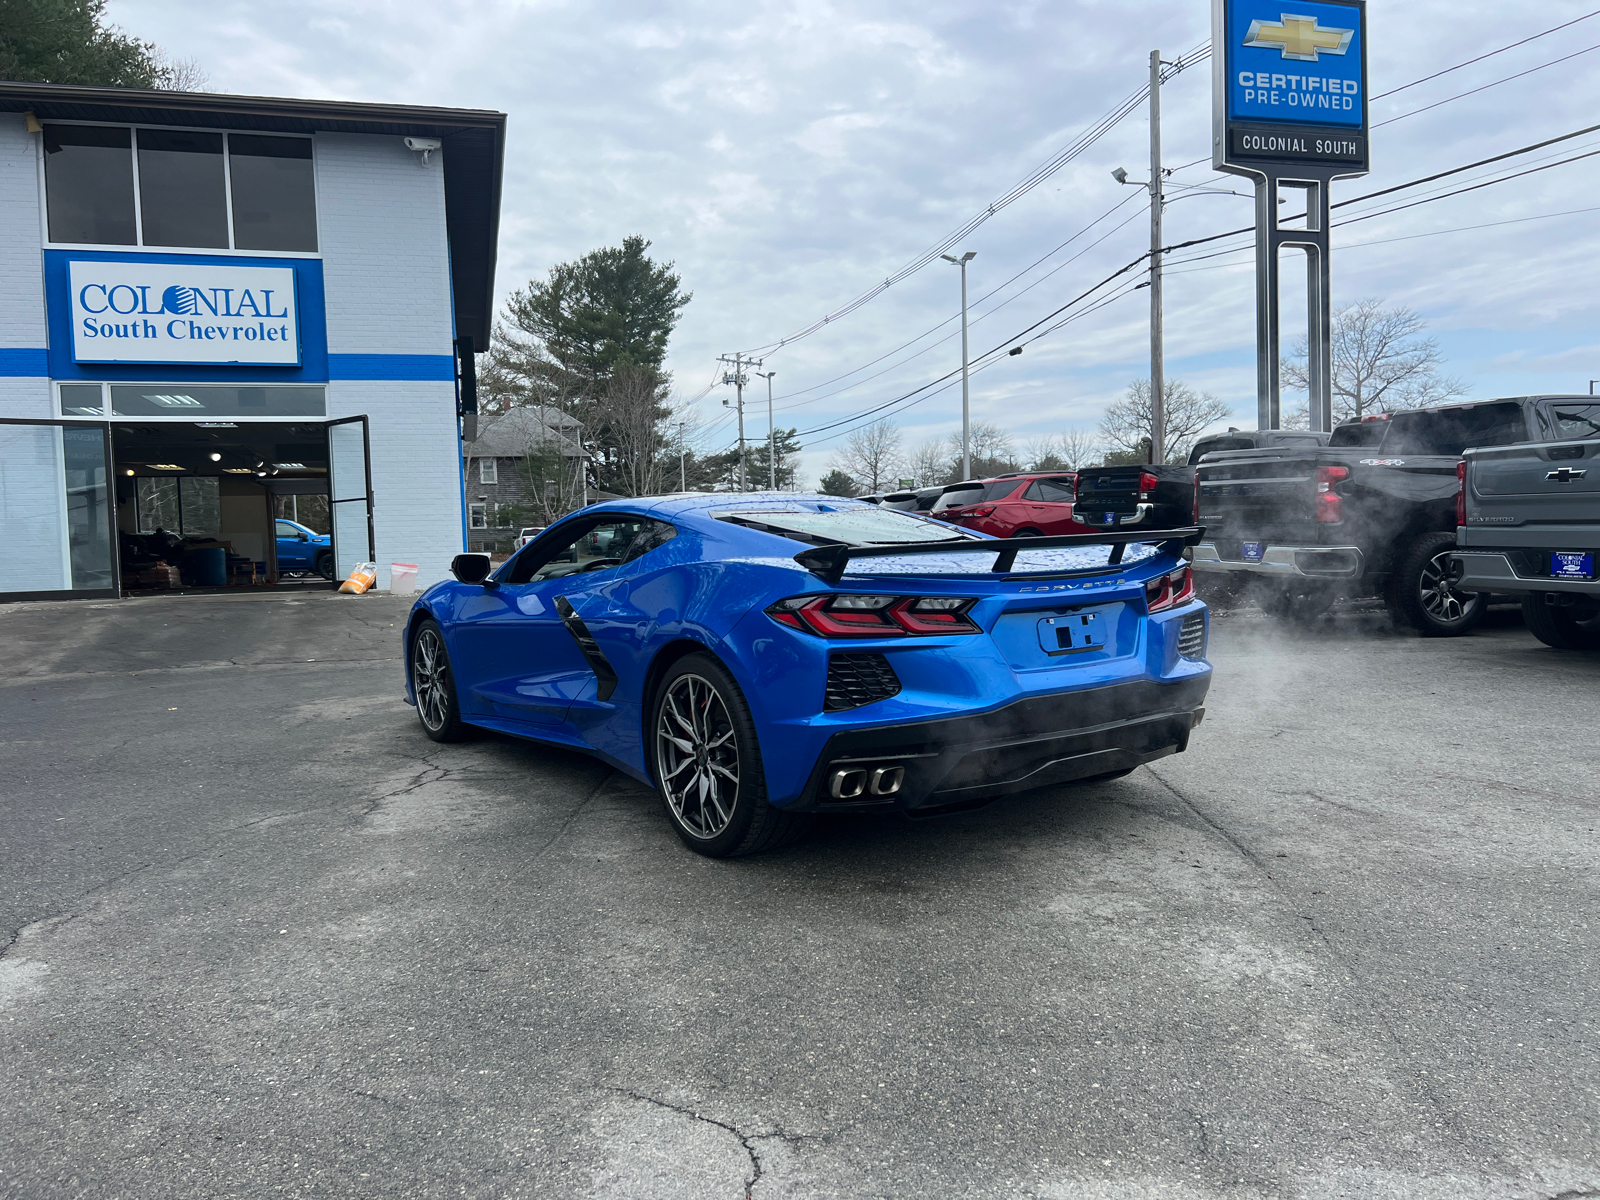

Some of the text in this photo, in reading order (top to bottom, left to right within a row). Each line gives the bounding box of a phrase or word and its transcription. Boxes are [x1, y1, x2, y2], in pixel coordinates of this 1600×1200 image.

[1238, 71, 1358, 95] CERTIFIED
[1245, 89, 1353, 110] PRE-OWNED
[1242, 135, 1356, 155] COLONIAL SOUTH
[80, 284, 288, 318] COLONIAL
[83, 318, 289, 341] South Chevrolet
[1019, 578, 1126, 593] CORVETTE
